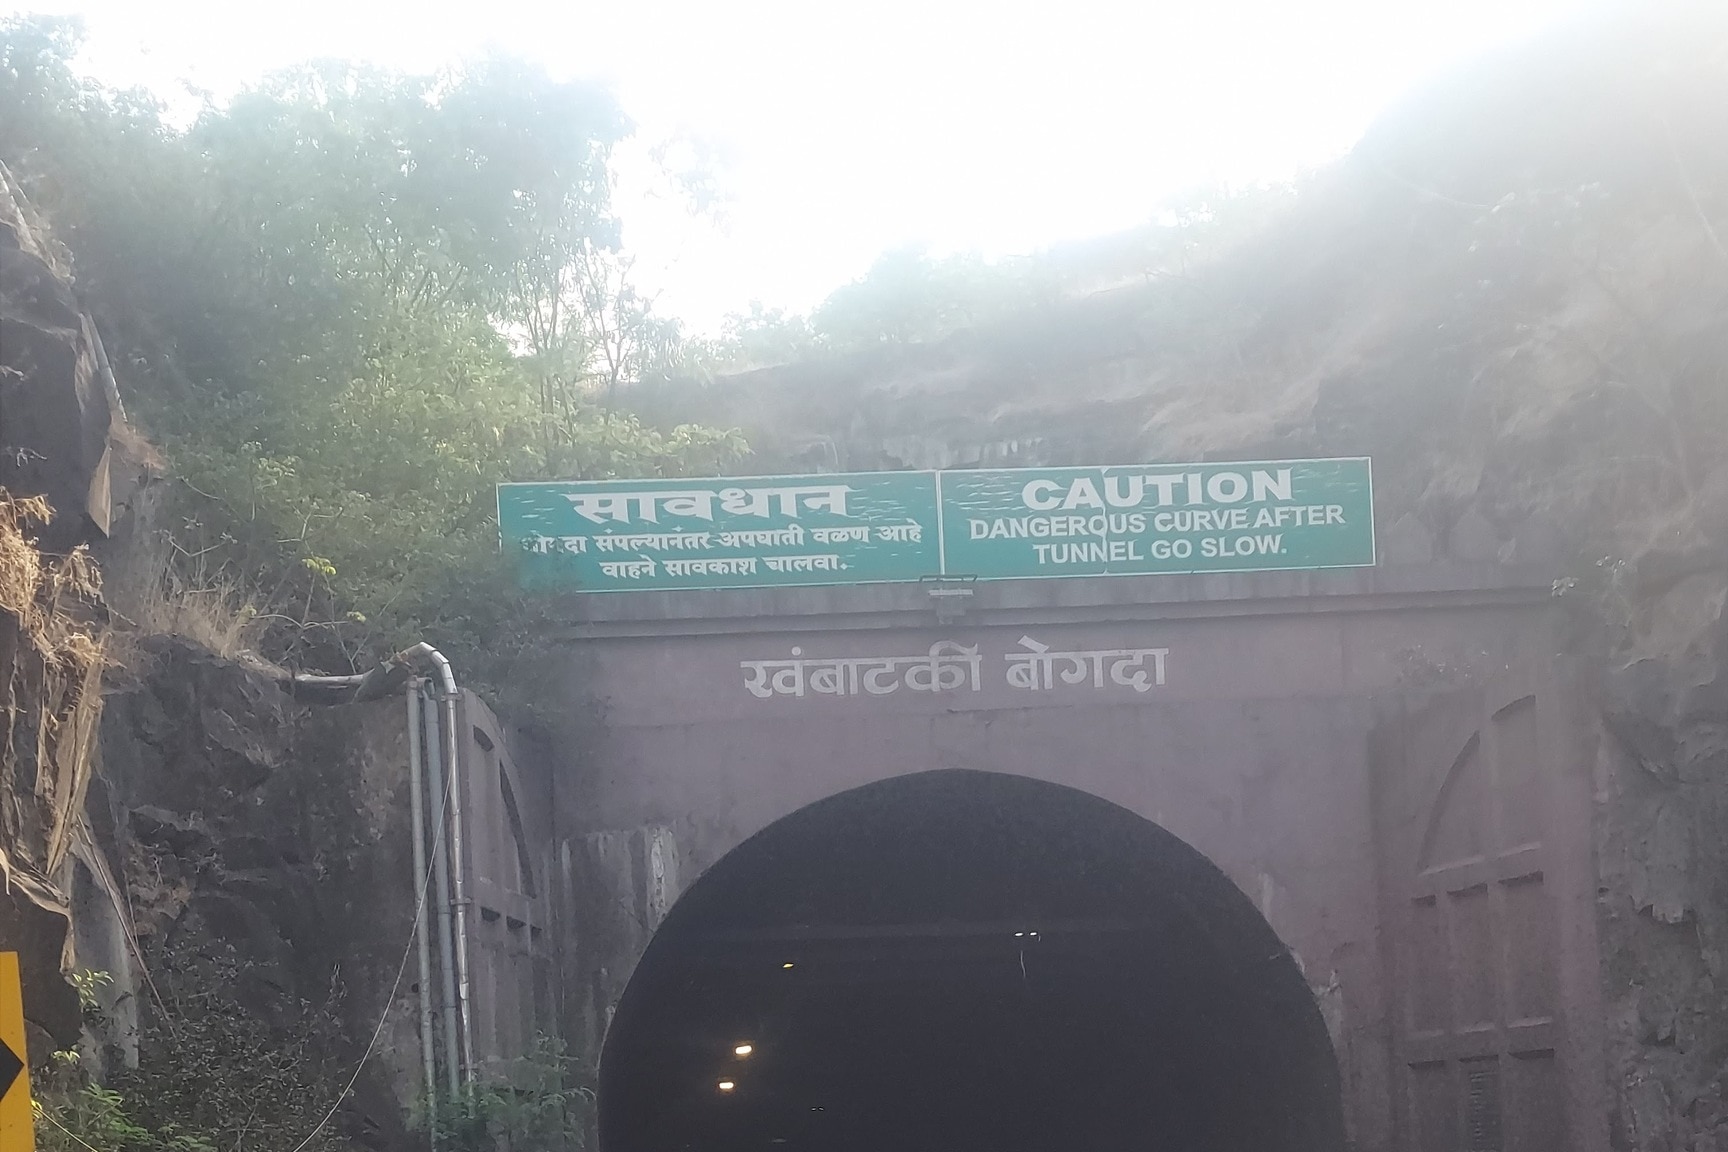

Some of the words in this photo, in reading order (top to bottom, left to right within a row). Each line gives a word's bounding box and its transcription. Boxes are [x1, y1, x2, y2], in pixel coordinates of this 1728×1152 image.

[559, 484, 850, 524] सावधान
[1021, 468, 1293, 511] CAUTION
[591, 526, 715, 552] संपल्यानंतर
[715, 523, 804, 548] अपघाती
[808, 526, 870, 544] वळण
[874, 518, 922, 543] आहे
[968, 512, 1146, 540] DANGEROUS
[1153, 507, 1250, 532] CURVE
[1251, 504, 1346, 529] AFTER
[599, 554, 657, 580] वाहने
[662, 557, 757, 577] सावकाश
[761, 553, 849, 574] चालवा.
[1032, 539, 1144, 564] TUNNEL
[1151, 538, 1192, 559] GO
[1200, 533, 1287, 558] SLOW.
[740, 640, 983, 698] खंबाटकी
[1005, 634, 1170, 692] बोगदा
